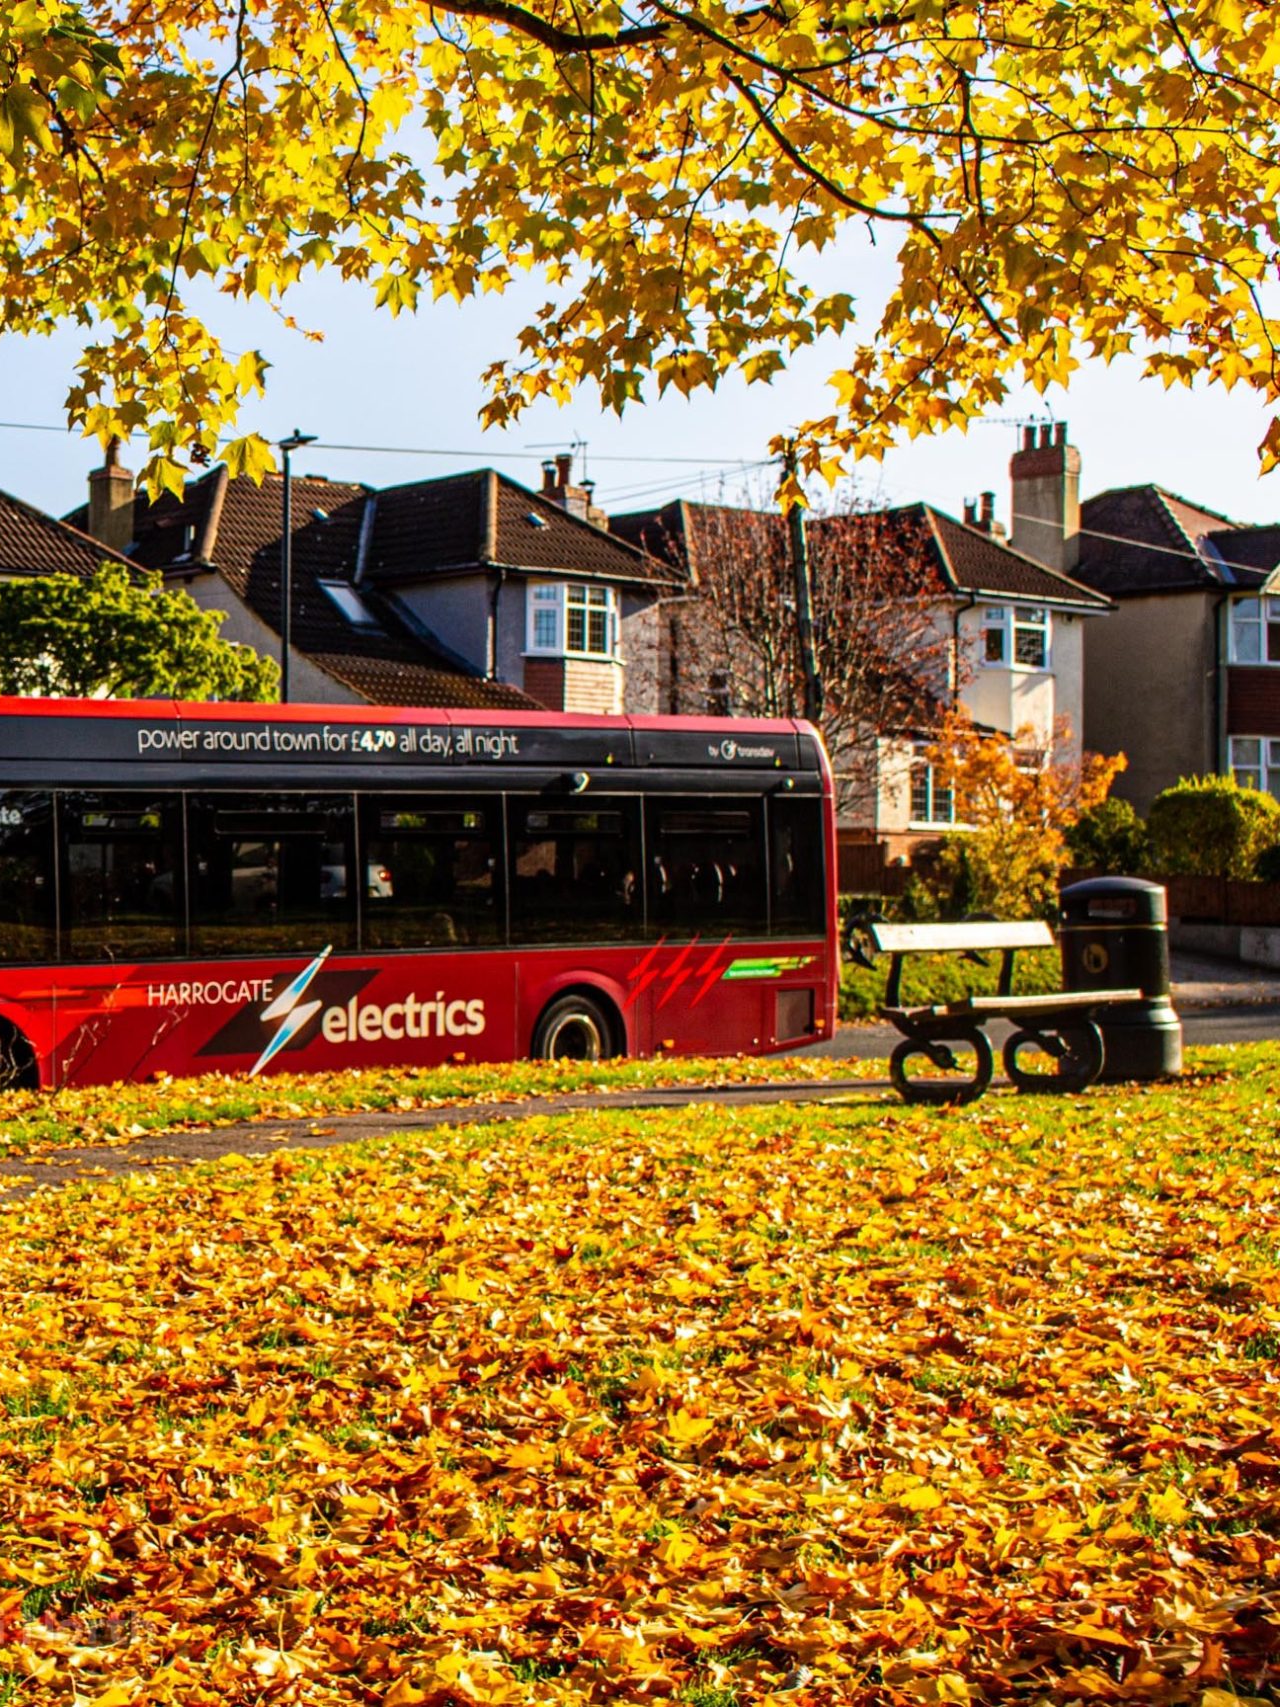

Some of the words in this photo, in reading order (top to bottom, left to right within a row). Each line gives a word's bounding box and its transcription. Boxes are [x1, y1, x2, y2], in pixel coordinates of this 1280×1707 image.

[138, 728, 200, 754] power
[202, 725, 270, 751] around
[273, 729, 321, 752] town
[322, 725, 348, 752] for
[351, 729, 396, 752] £4.70
[399, 727, 418, 752] all
[419, 728, 454, 758] day,
[455, 728, 474, 755] all
[475, 729, 520, 760] night
[147, 979, 274, 1006] HARROGATE
[321, 991, 486, 1044] electrics
